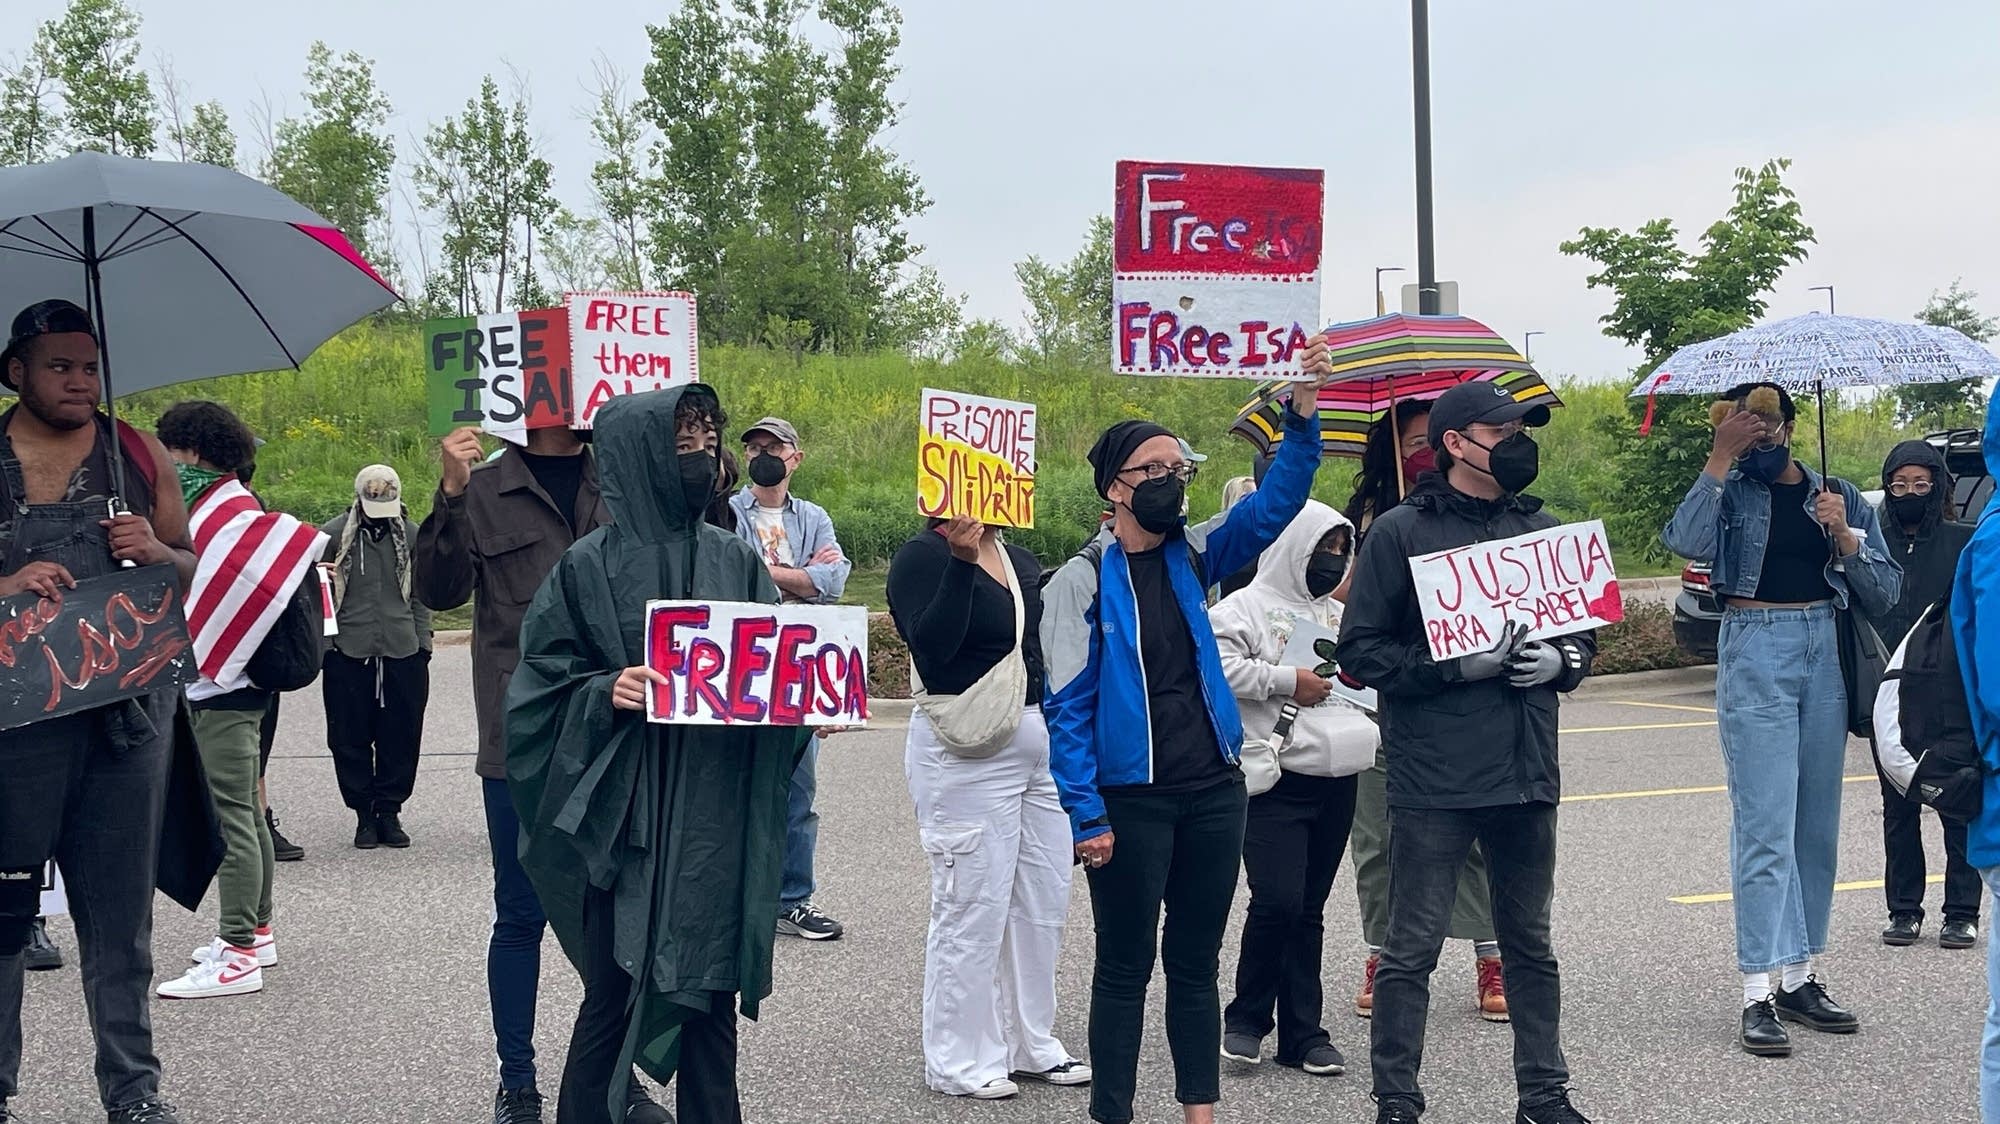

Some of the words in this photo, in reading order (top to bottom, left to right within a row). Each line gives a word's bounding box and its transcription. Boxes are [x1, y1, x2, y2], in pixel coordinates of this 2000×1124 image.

[1139, 169, 1249, 255] Free
[585, 300, 671, 336] FREE
[432, 319, 548, 371] FREE
[594, 343, 671, 379] them
[452, 367, 574, 423] ISA!
[1820, 365, 1862, 380] PARIS
[1422, 532, 1614, 612] JUSTICIA
[1427, 614, 1491, 658] PARA
